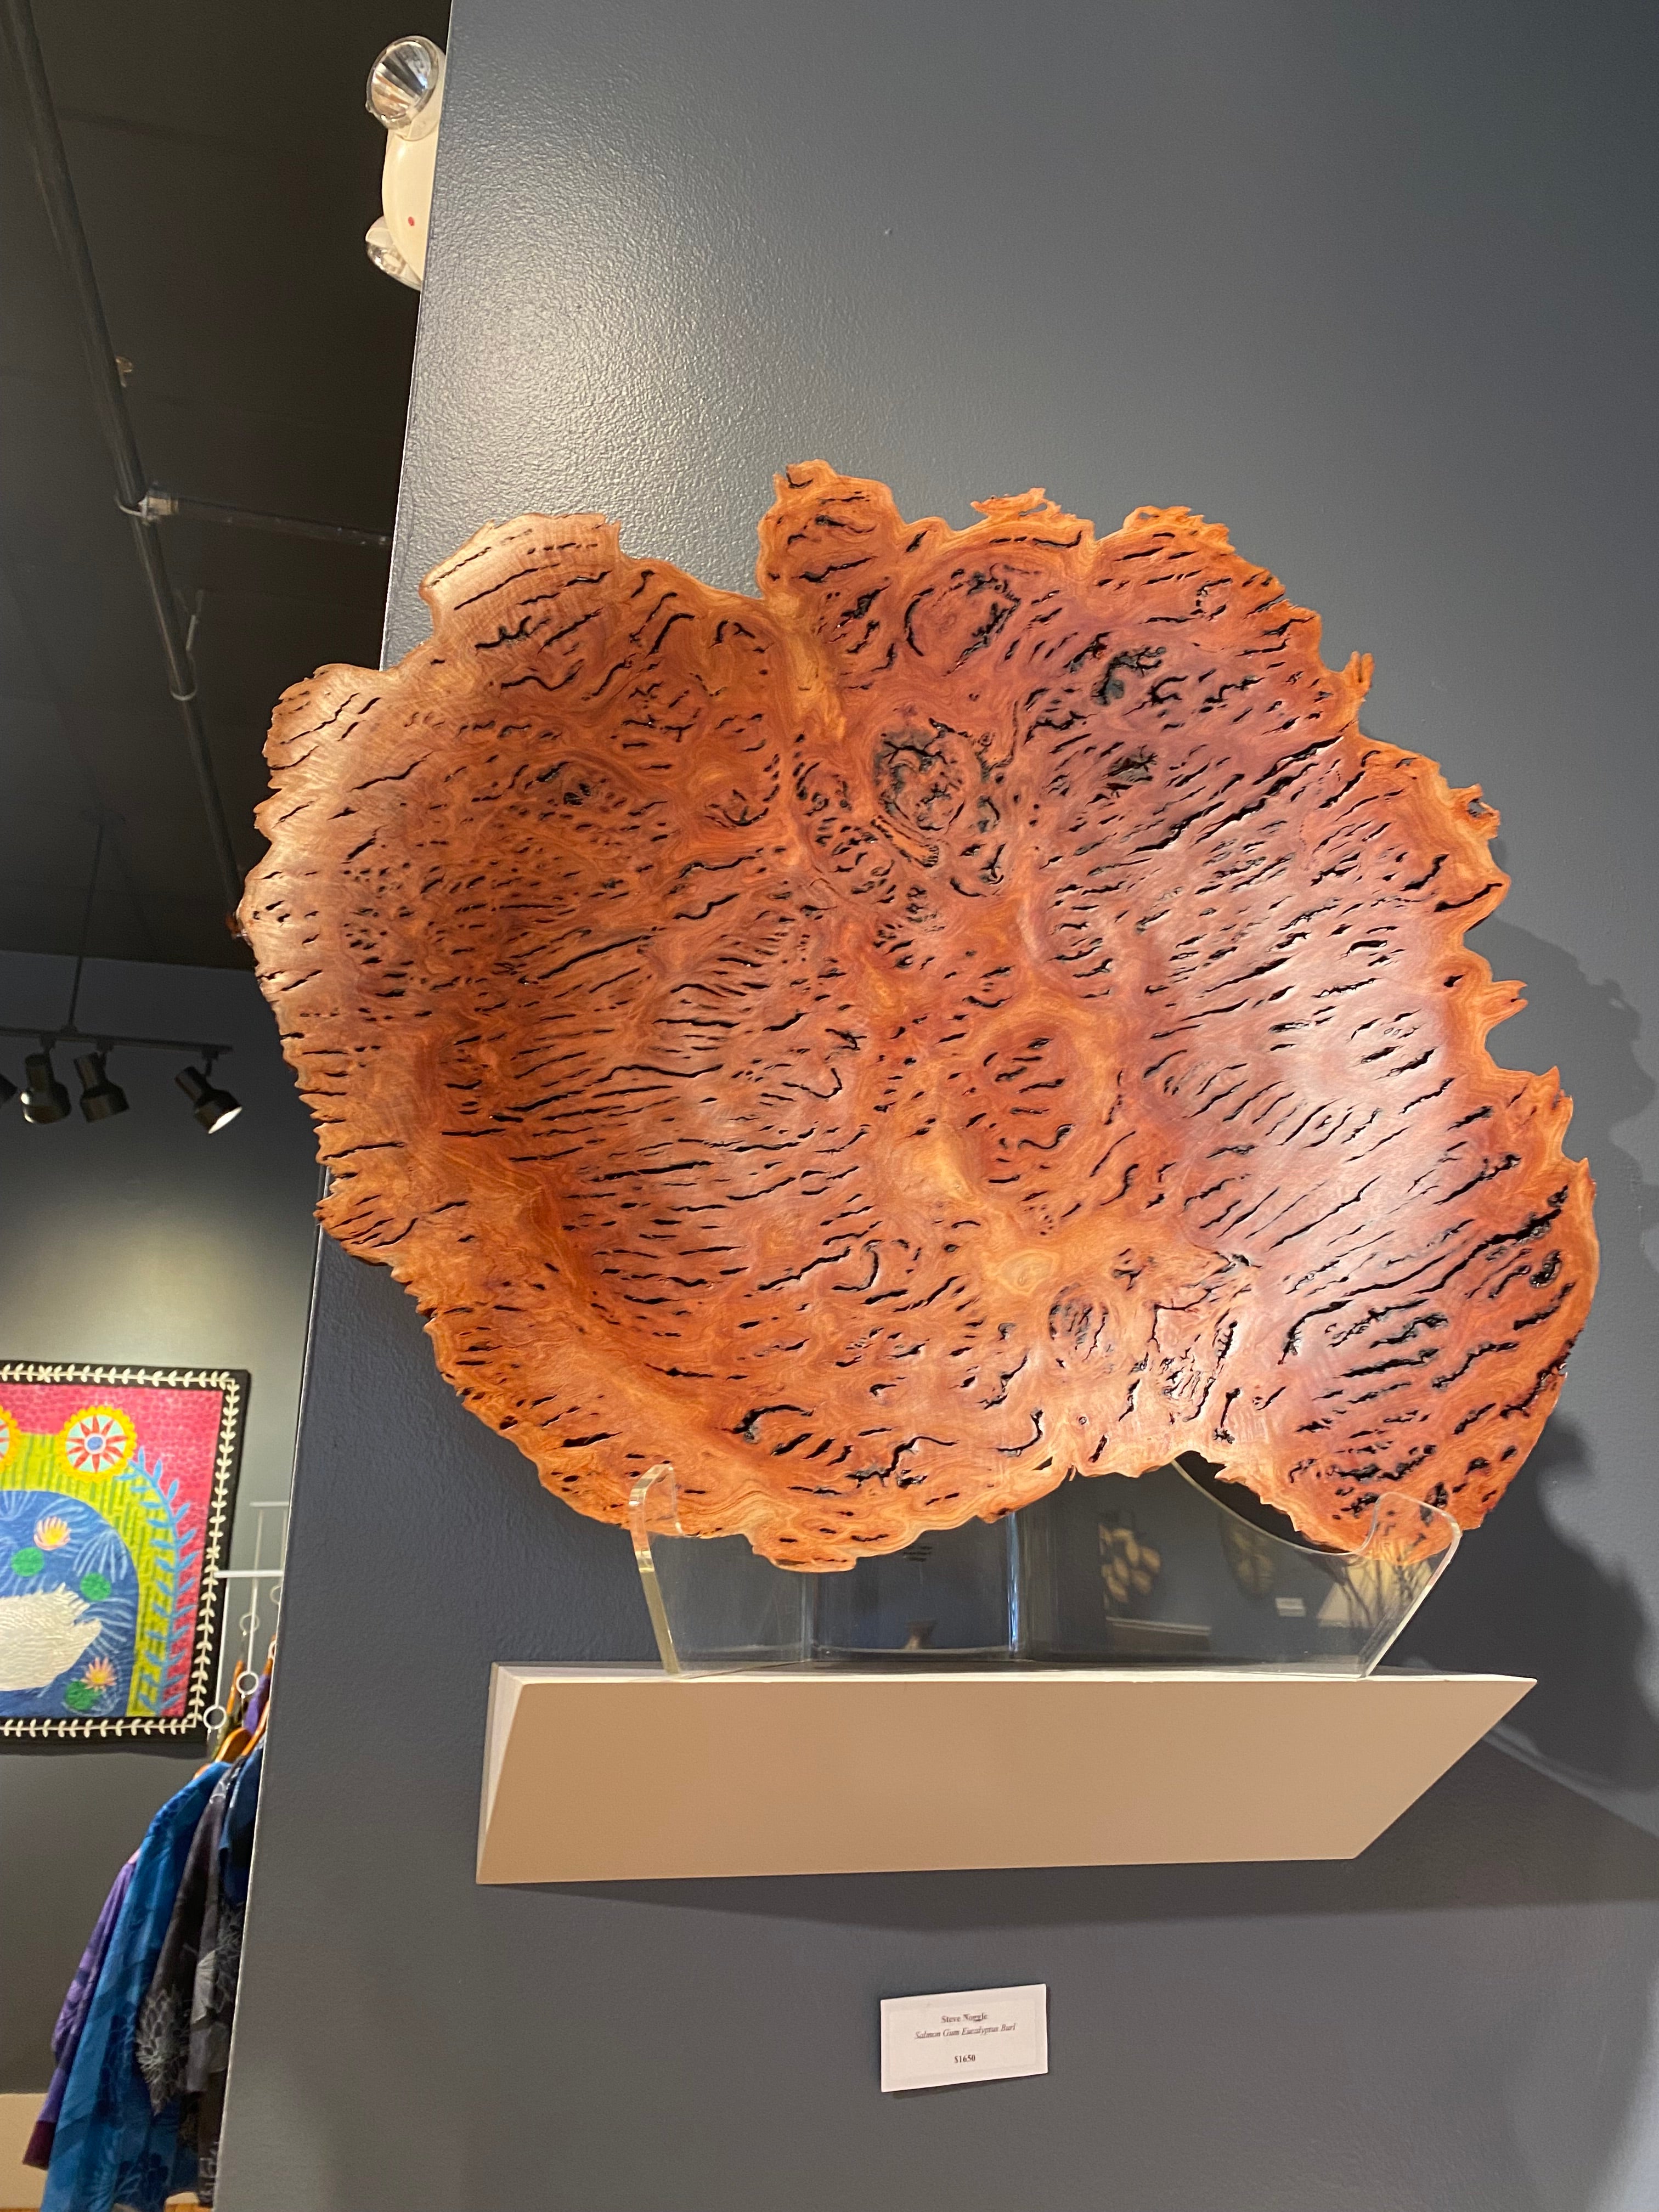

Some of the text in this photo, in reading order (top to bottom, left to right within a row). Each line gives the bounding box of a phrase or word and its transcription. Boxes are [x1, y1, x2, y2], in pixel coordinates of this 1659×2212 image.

[941, 2015, 961, 2023] Steve
[915, 2030, 941, 2039] Salmon
[962, 2026, 998, 2035] Eucalyptus
[1001, 2023, 1016, 2032] Burl
[954, 2055, 976, 2063] $1650
